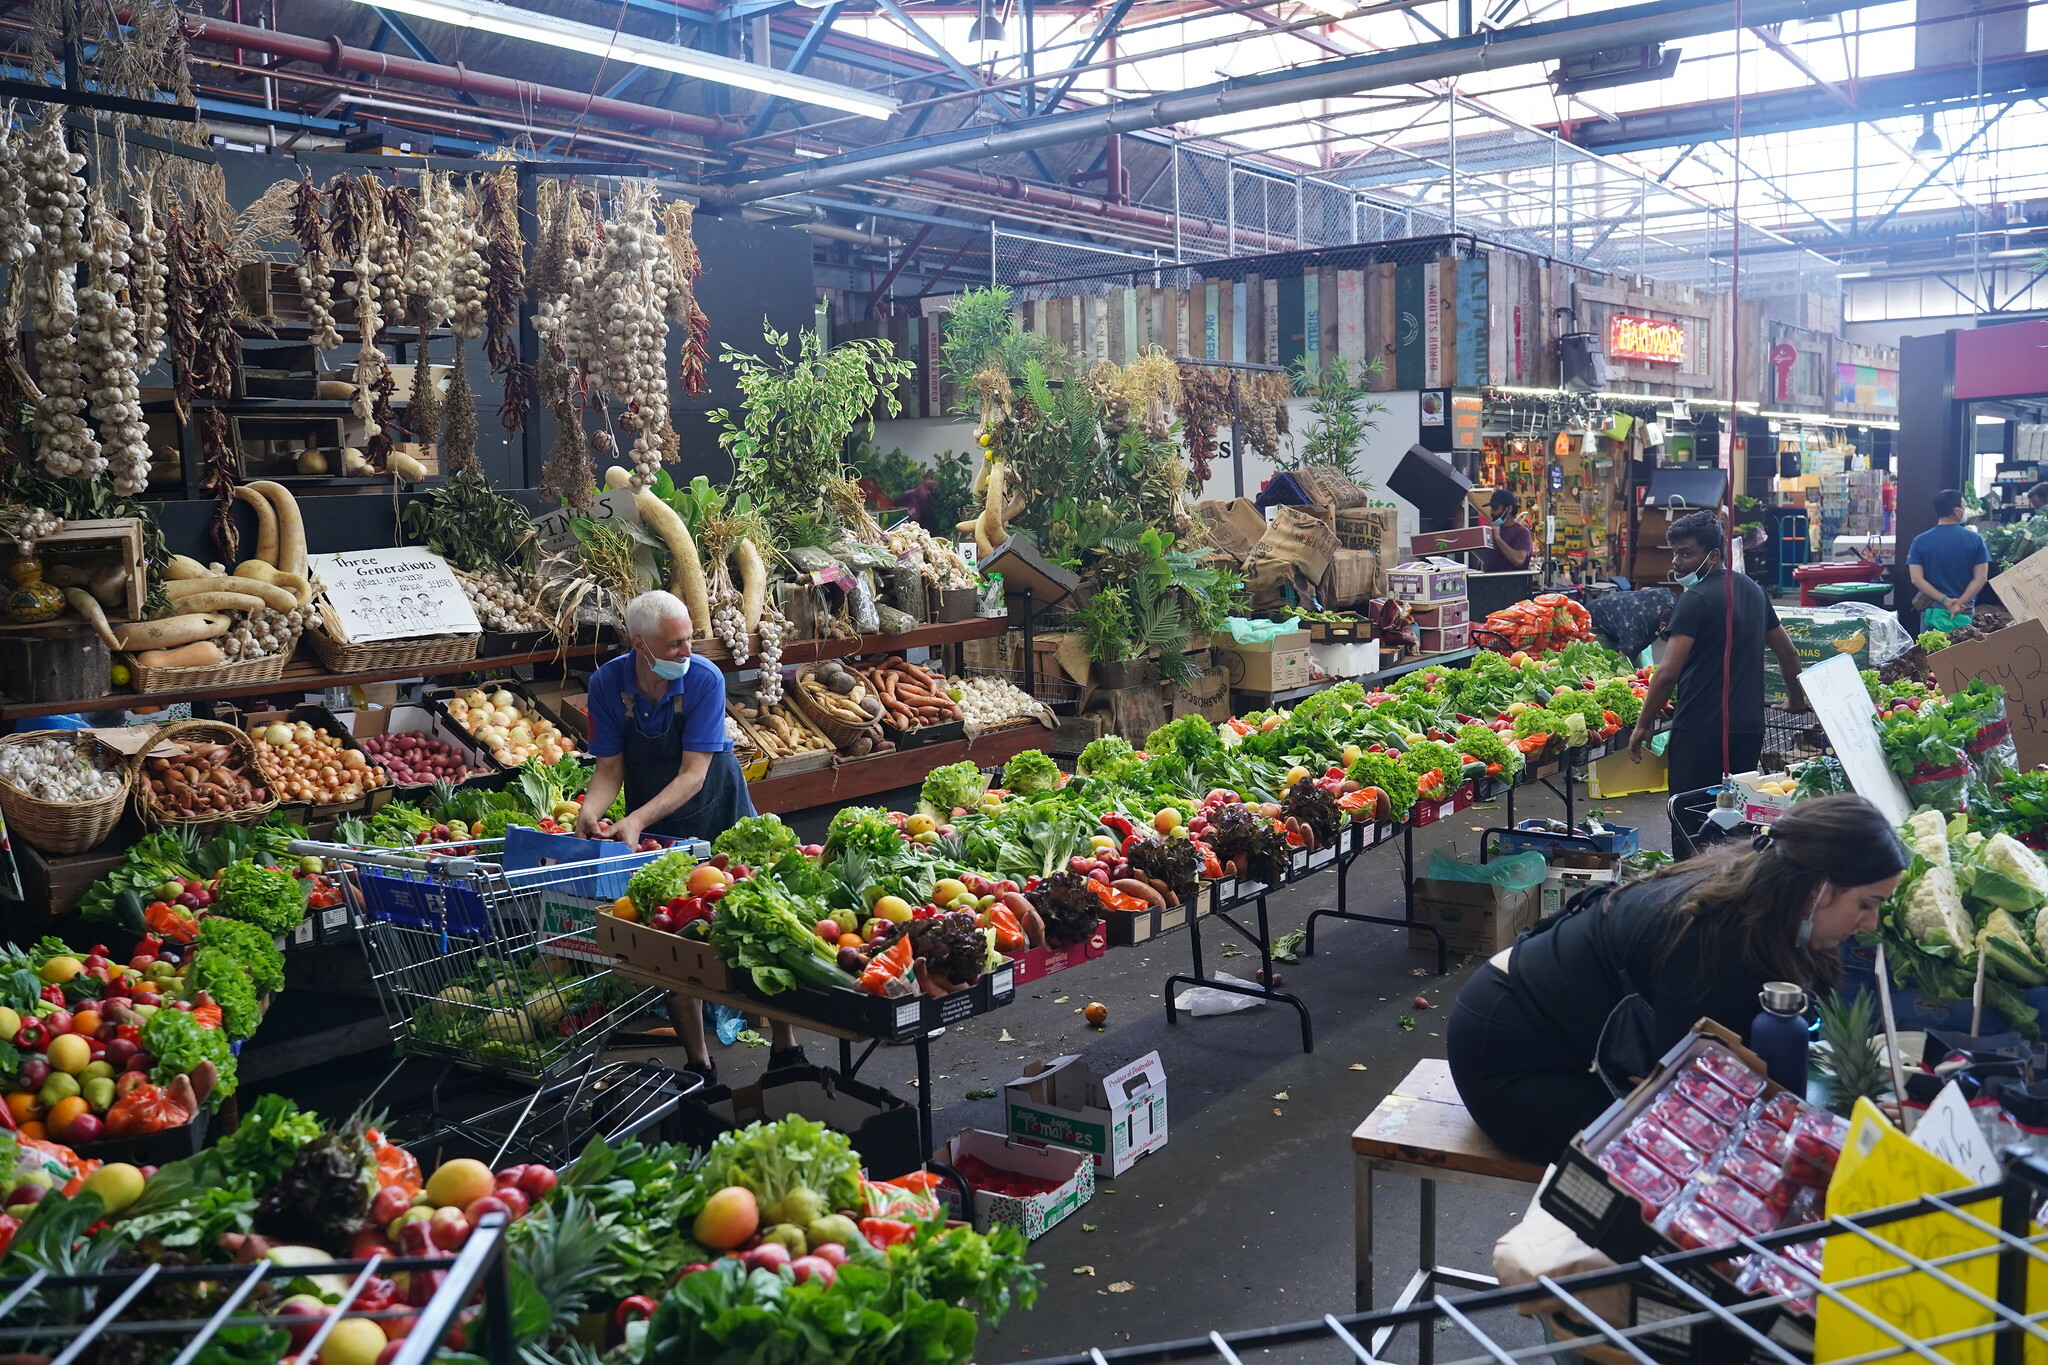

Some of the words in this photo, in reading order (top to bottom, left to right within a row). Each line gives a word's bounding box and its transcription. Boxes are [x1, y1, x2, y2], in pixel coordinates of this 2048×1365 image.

[1427, 284, 1438, 336] ARNOTTS
[1308, 310, 1320, 352] CITRUS
[1619, 325, 1684, 356] HARDWARE
[332, 556, 377, 569] Three
[357, 559, 436, 577] Generations
[335, 579, 347, 590] of
[428, 578, 453, 590] 1958
[1953, 664, 2024, 702] Any
[2014, 644, 2048, 680] 2
[1108, 1071, 1127, 1088] Produce
[1131, 1059, 1155, 1076] Australia
[1118, 1150, 1137, 1165] Produce
[1141, 1133, 1163, 1151] Australia
